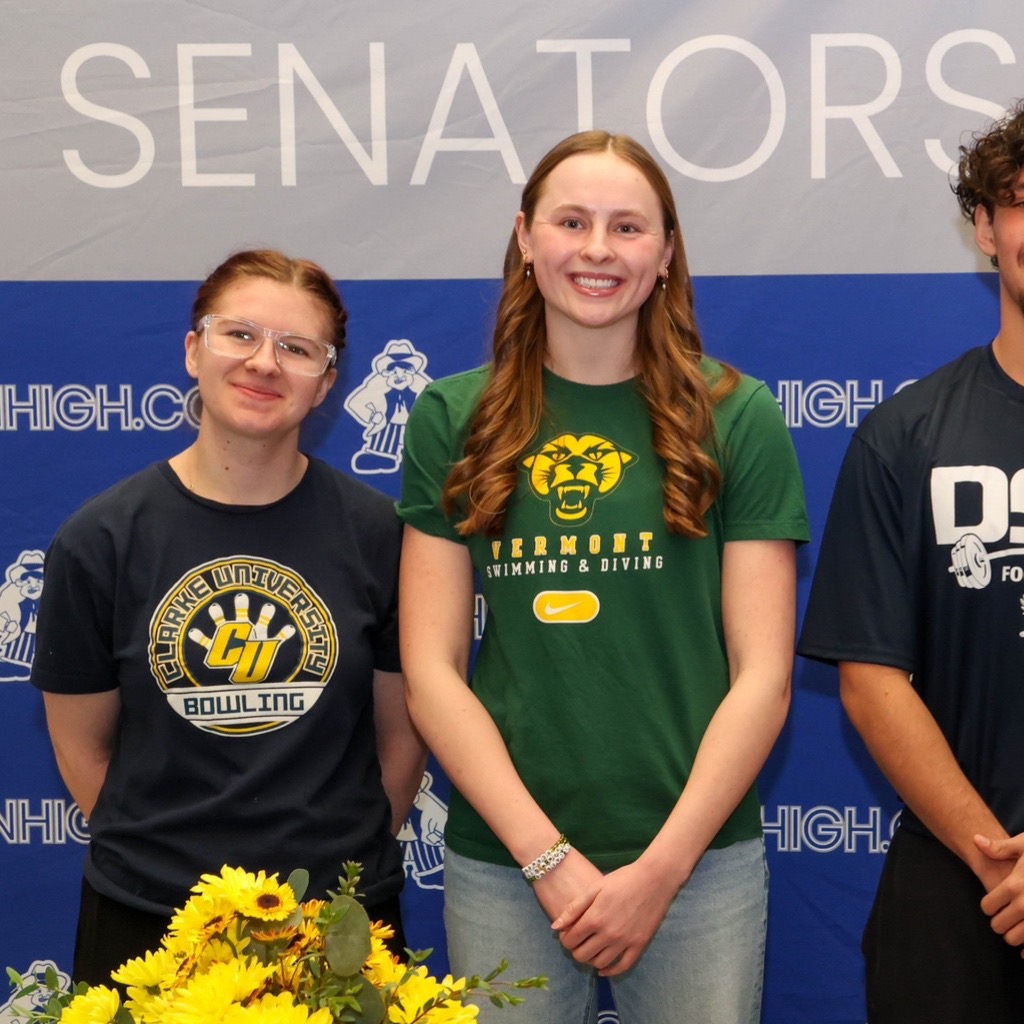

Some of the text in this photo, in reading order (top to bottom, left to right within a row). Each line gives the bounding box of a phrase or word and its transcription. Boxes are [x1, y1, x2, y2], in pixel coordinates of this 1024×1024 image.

[60, 29, 1016, 188] SENATORS
[0, 384, 201, 431] HIGH.C
[486, 556, 664, 578] SWIMMING & DIVING
[491, 532, 653, 560] VERMONT
[157, 564, 331, 684] CLARKE UNIVERSITY
[203, 621, 281, 684] CU
[183, 693, 305, 716] BOWLING
